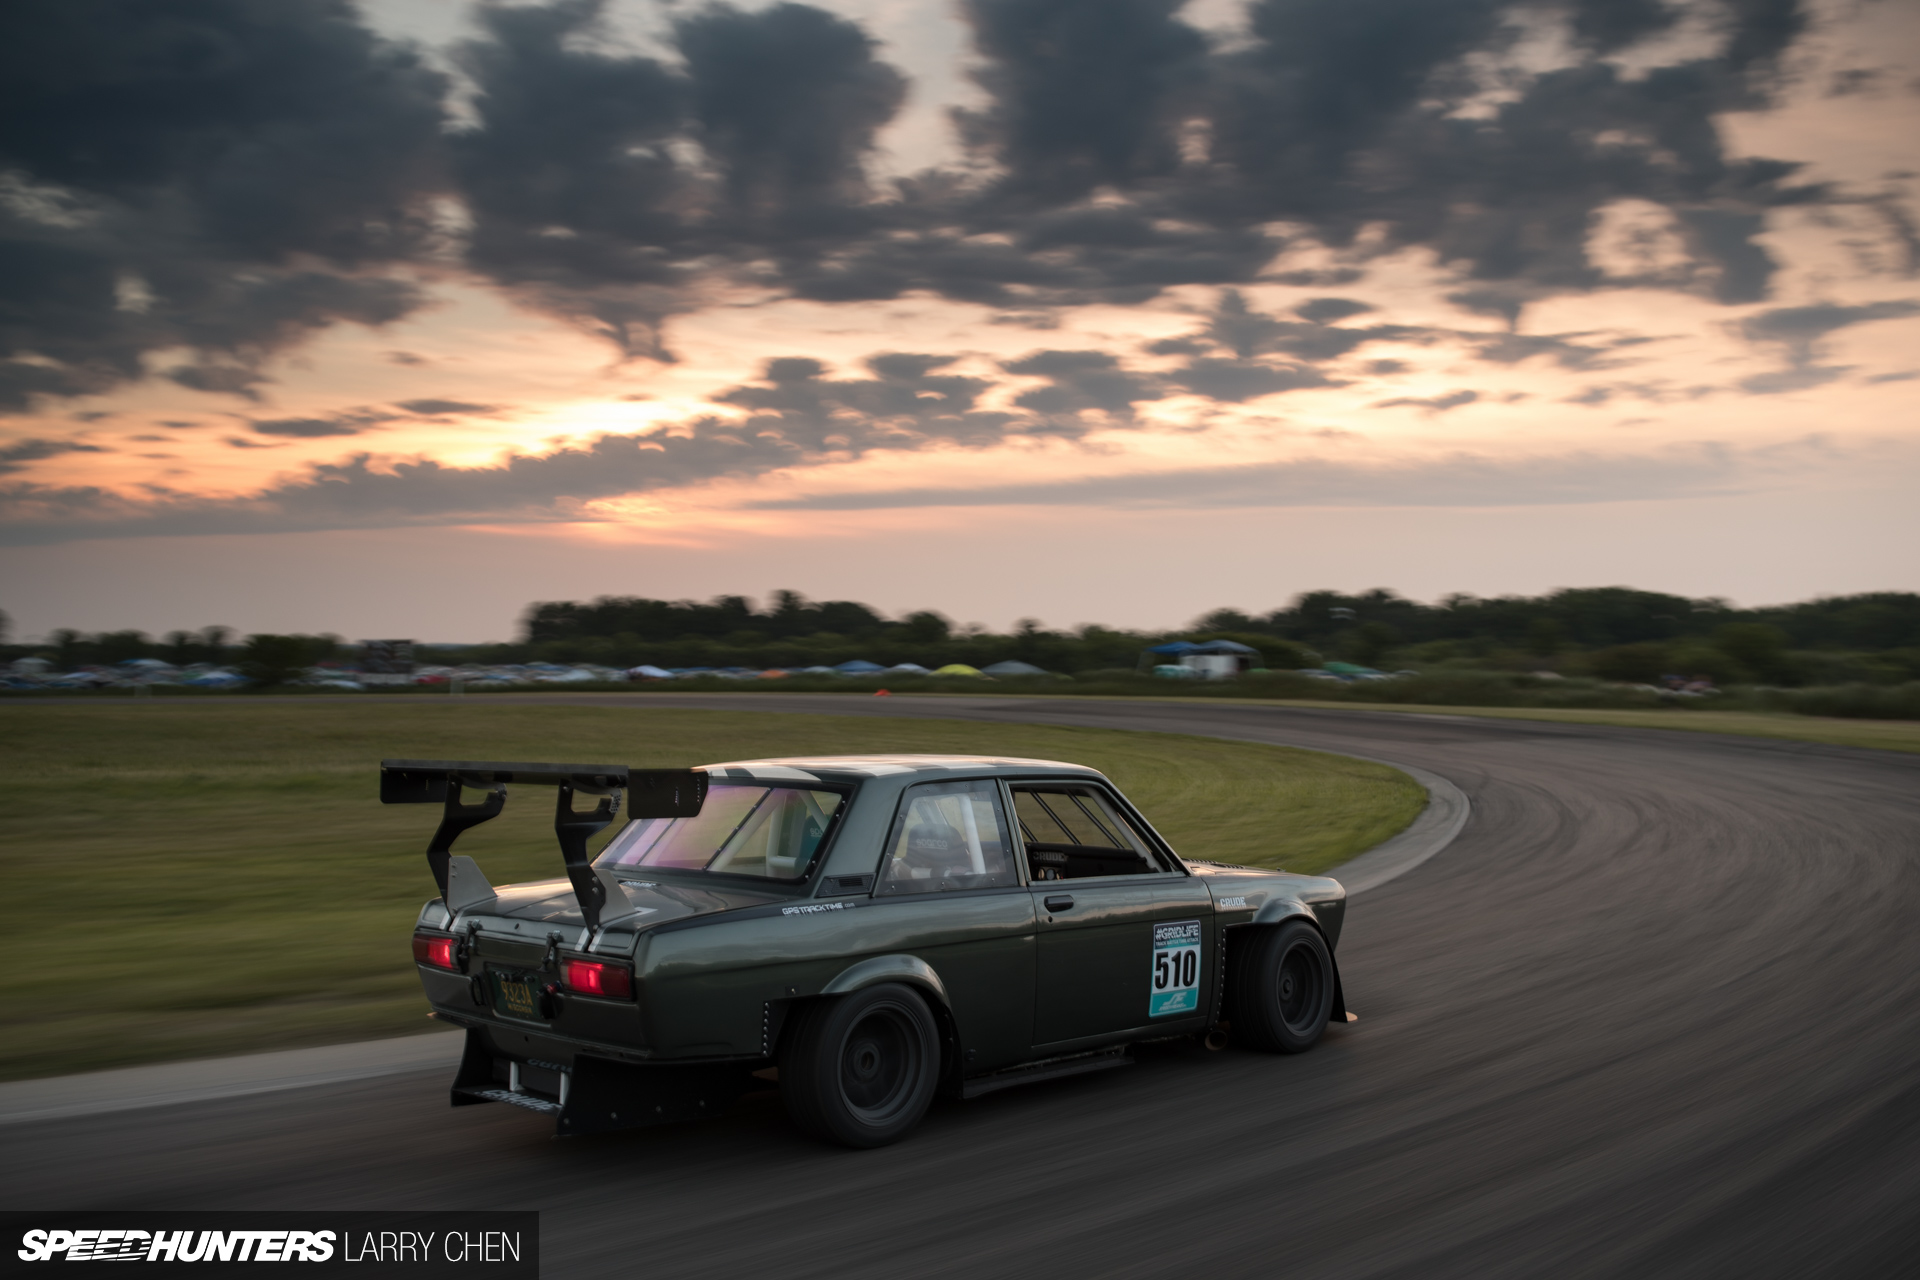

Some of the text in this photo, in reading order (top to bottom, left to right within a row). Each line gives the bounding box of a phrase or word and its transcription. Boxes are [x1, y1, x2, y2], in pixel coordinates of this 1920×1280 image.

[1220, 896, 1246, 908] CRUDE
[1155, 924, 1199, 940] #GRIDLIFE
[1154, 950, 1197, 989] 510
